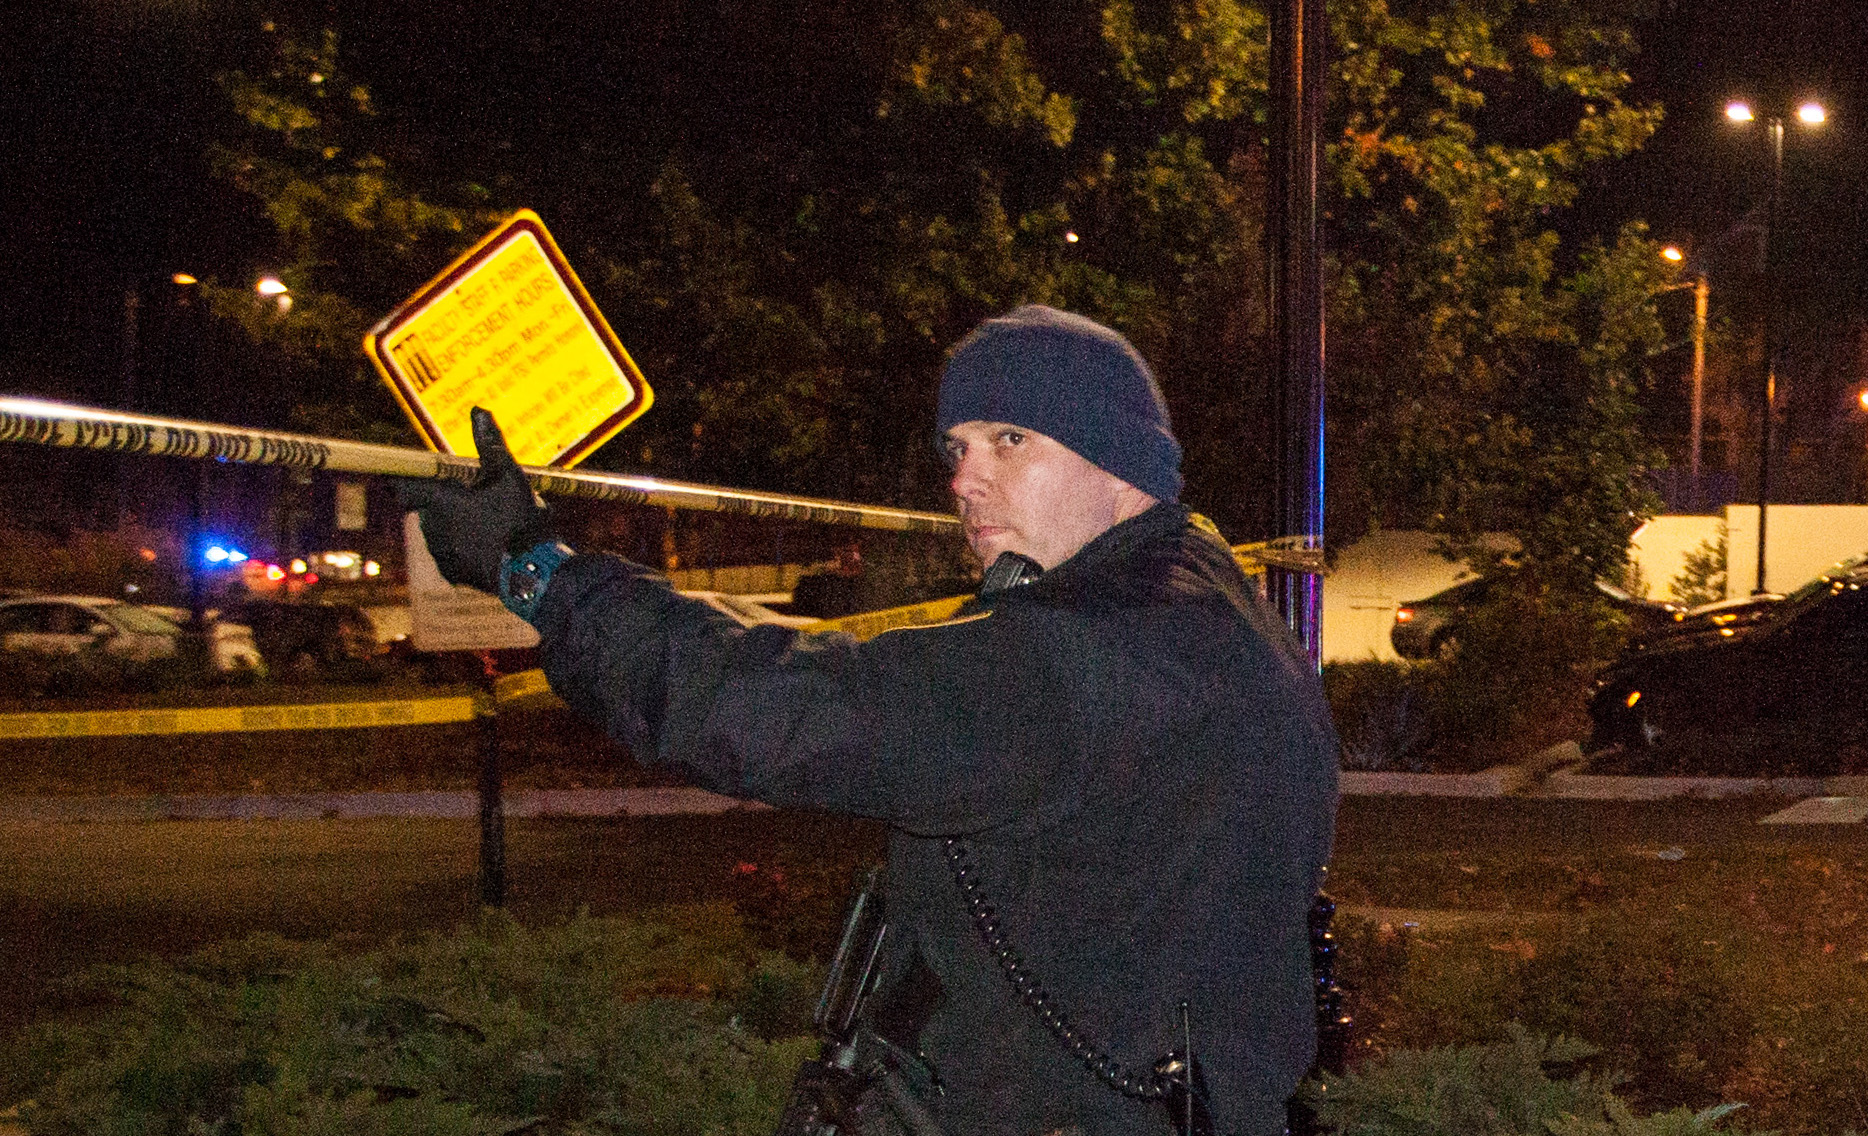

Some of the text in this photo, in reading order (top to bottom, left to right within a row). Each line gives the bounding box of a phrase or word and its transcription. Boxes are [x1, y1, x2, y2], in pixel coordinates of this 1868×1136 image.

[458, 283, 494, 319] STAFF
[497, 244, 543, 288] PARKING
[434, 301, 516, 374] ENFORCEMENT
